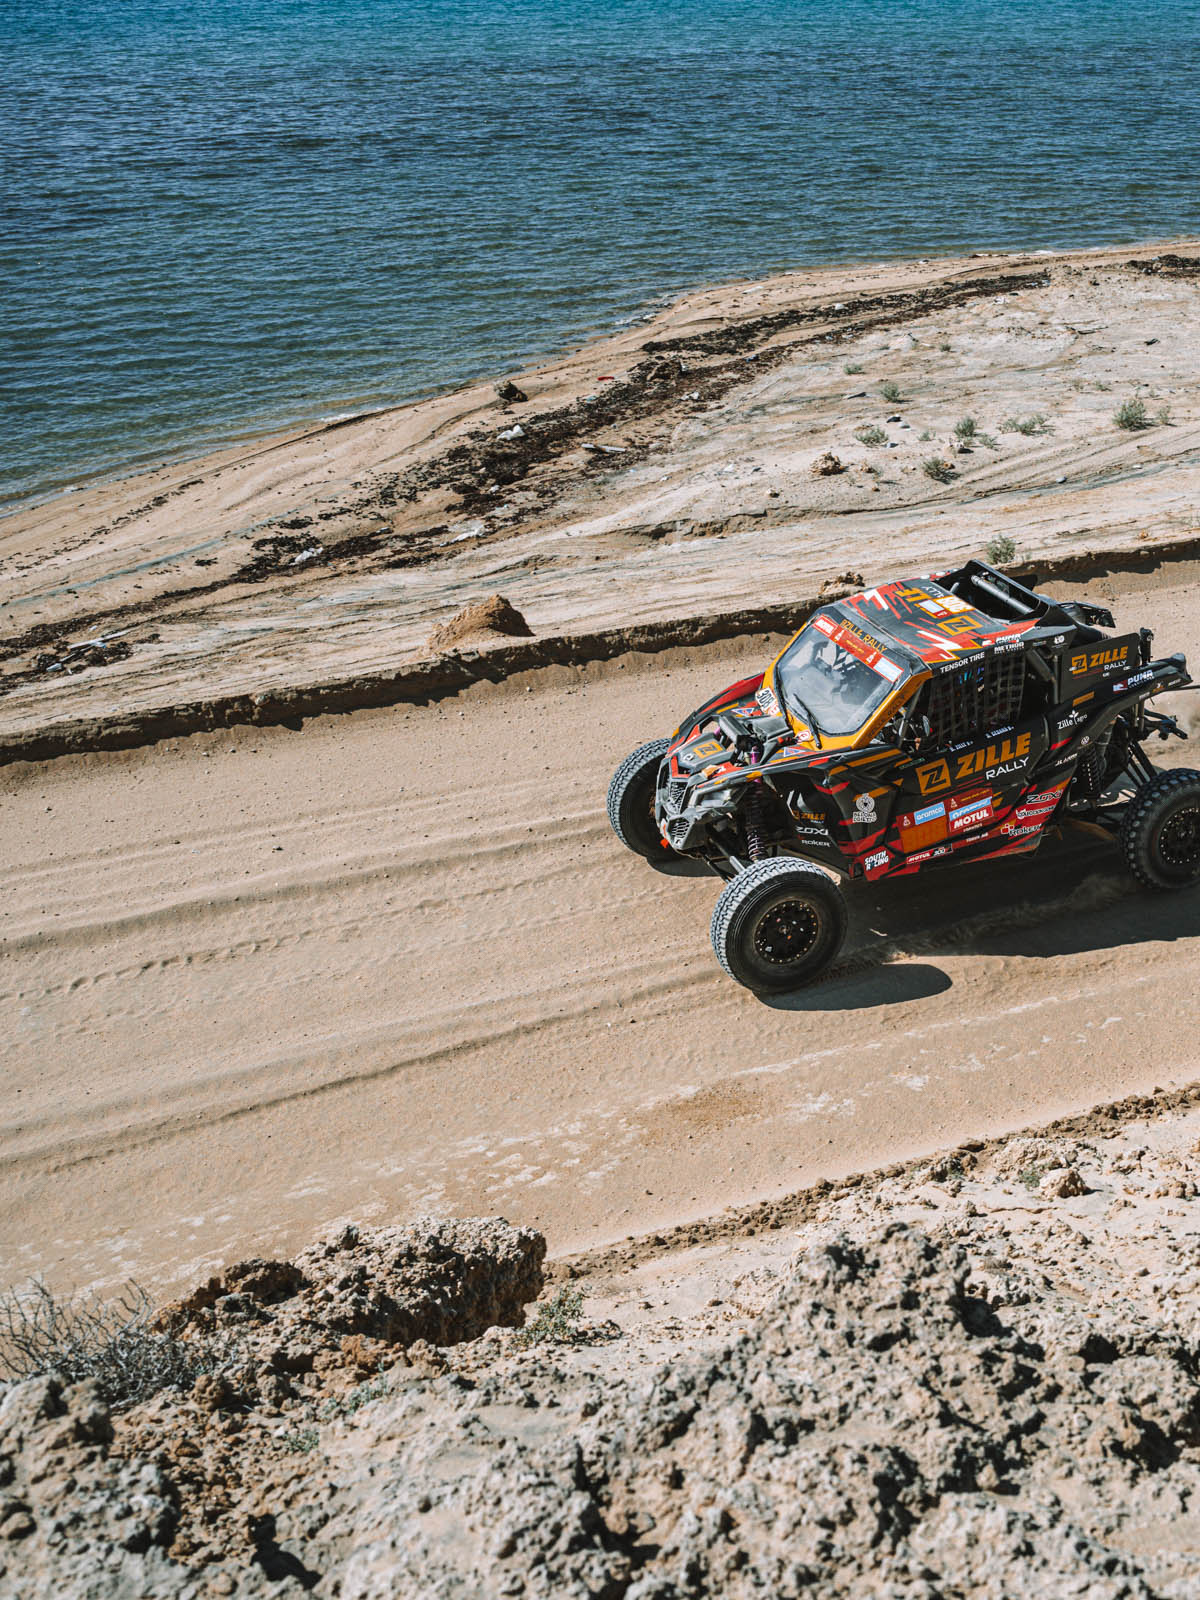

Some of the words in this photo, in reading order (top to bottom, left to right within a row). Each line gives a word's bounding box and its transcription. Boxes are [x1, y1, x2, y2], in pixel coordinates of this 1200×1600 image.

[863, 635, 887, 653] RALLY
[940, 658, 969, 674] TENSOR
[970, 651, 985, 665] TIRE
[1089, 646, 1129, 668] ZILLE
[1104, 660, 1127, 671] RALLY
[1057, 717, 1074, 730] Zille
[954, 732, 1031, 780] ZILLE
[985, 756, 1030, 780] RALLY
[916, 806, 943, 821] aramco
[953, 809, 990, 830] MOTUL
[865, 851, 887, 865] SOUTH
